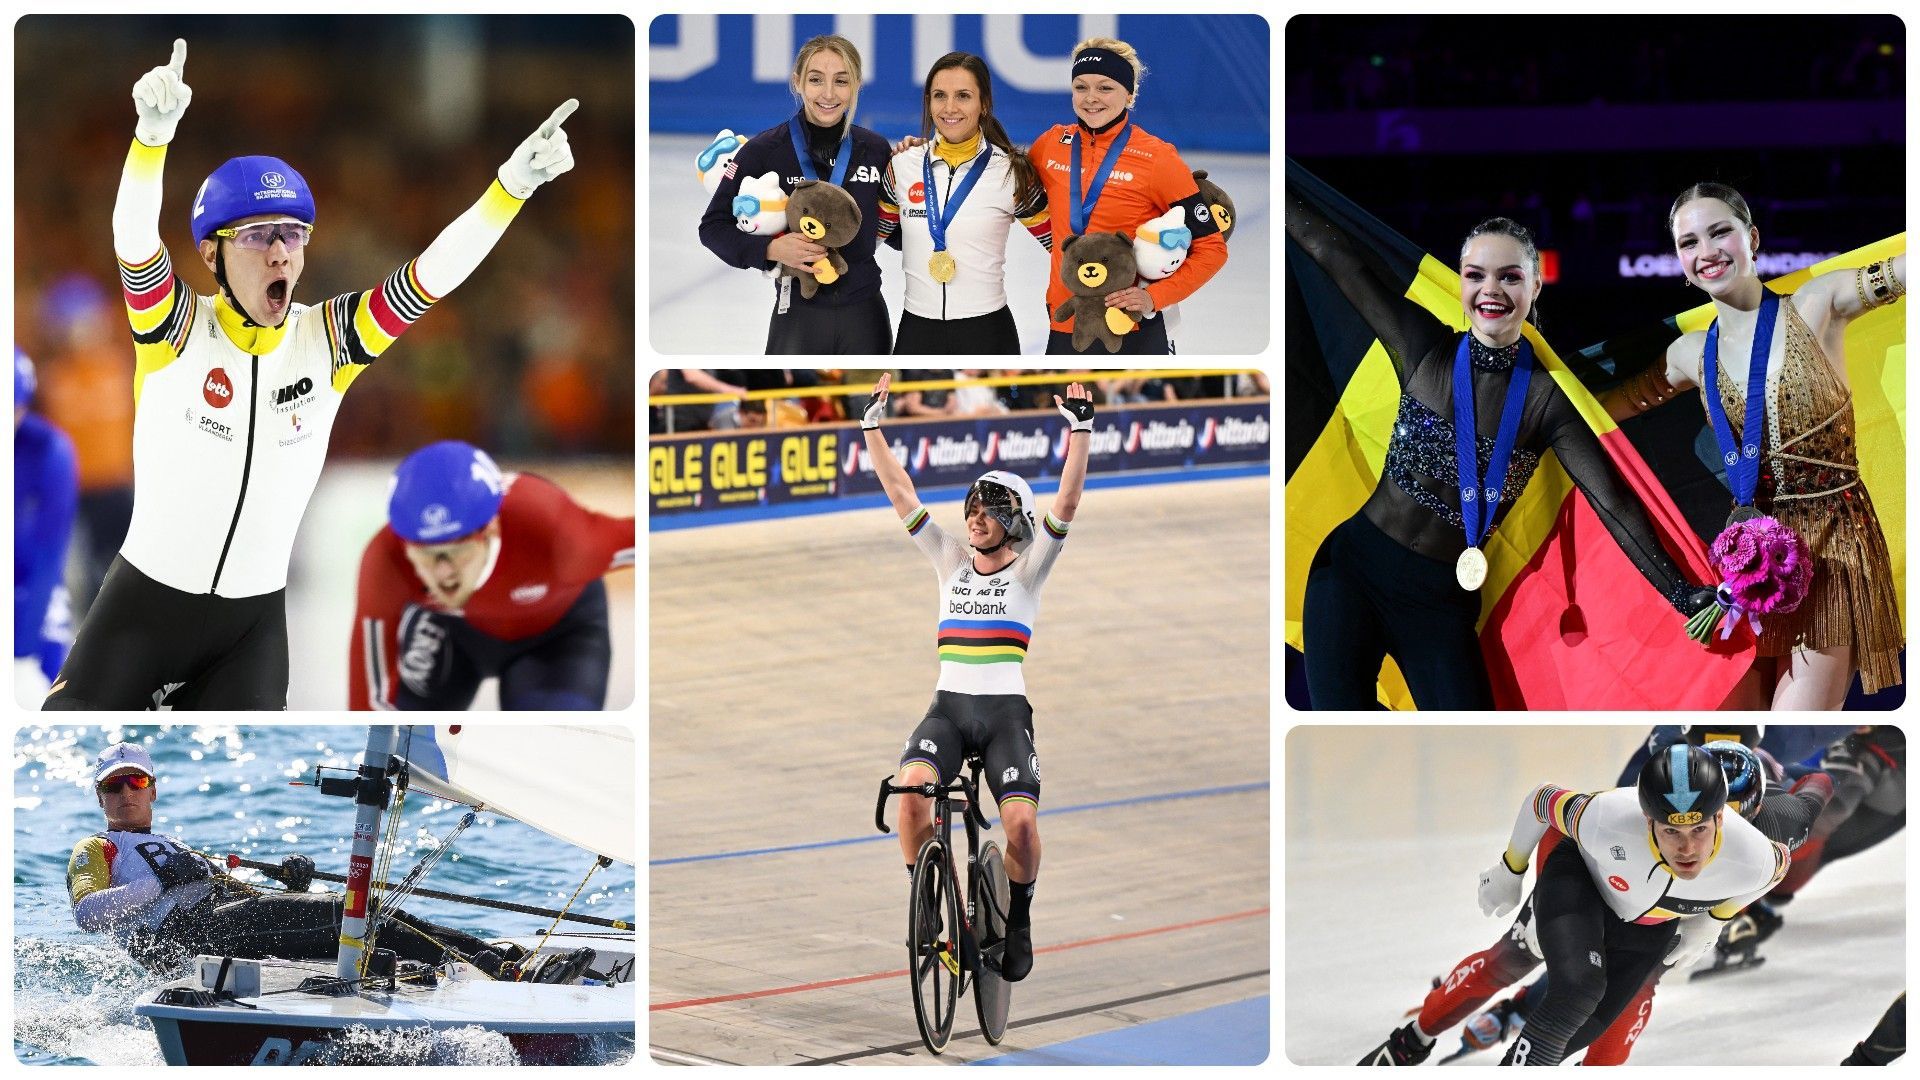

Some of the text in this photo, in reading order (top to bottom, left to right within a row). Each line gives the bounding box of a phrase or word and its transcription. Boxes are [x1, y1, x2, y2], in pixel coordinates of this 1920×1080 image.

[850, 166, 880, 182] SA
[206, 377, 230, 398] lotto
[994, 588, 1007, 597] EY
[1624, 1000, 1650, 1046] CAN
